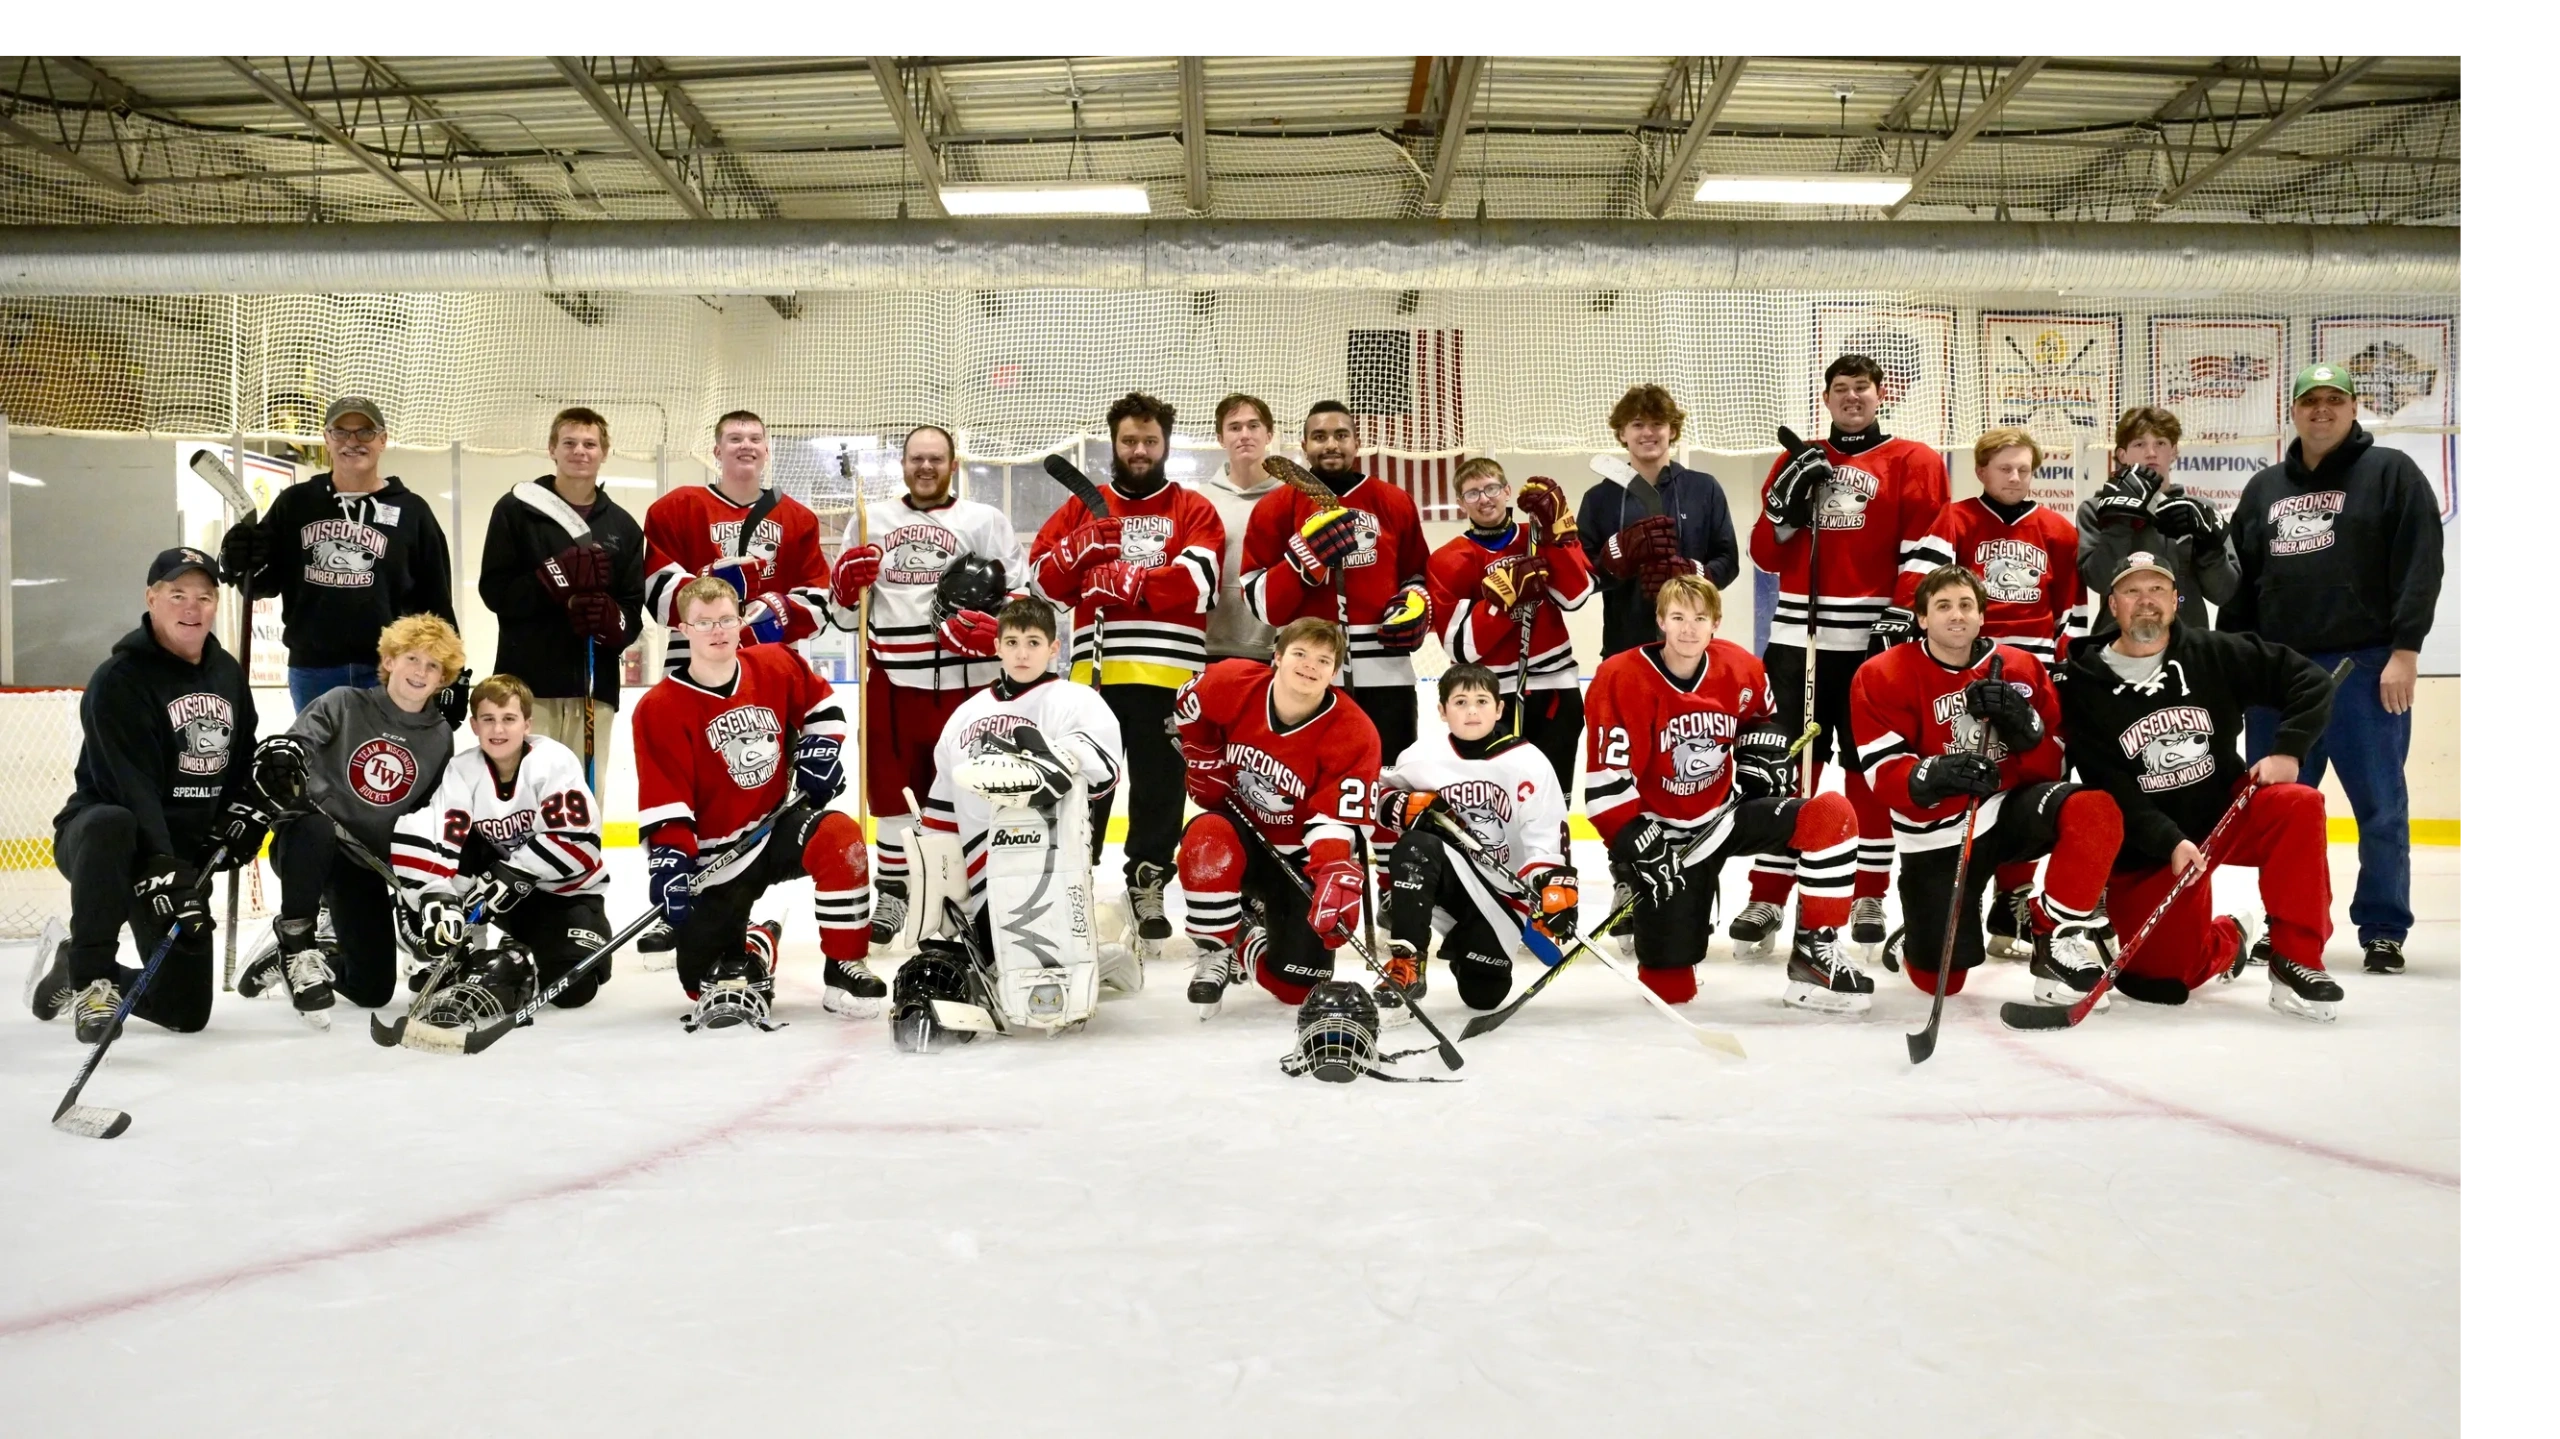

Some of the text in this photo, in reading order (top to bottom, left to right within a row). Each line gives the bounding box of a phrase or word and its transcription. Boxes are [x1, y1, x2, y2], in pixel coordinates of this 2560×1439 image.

[2176, 456, 2269, 471] HAMPIONS
[1828, 466, 1879, 500] CONSIN
[2268, 492, 2344, 523] WISCONSIN
[1121, 515, 1173, 536] CONSIN
[1829, 515, 1864, 528] WOLVES
[885, 525, 956, 556] WISCONSIN
[2298, 534, 2333, 552] WOLVES
[1348, 552, 1377, 567] WOLVES
[304, 567, 373, 586] TIMBER WOLVES
[885, 568, 912, 584] TIMBER
[2008, 588, 2040, 601] WOLVES
[168, 692, 233, 730] WISCONSIN
[382, 731, 407, 742] CCM
[2121, 706, 2214, 759] WISCONSIN
[794, 746, 839, 761] AUER
[1598, 726, 1631, 767] 2
[180, 753, 206, 772] TIMBER
[358, 743, 414, 776] TEAM WISCONSIN
[369, 757, 403, 789] TW
[1225, 743, 1307, 801] WISCONSIN
[2141, 757, 2214, 792] TIMBER WOLVES
[172, 786, 211, 798] SPECIAL
[359, 783, 391, 803] HOCKEY
[1517, 780, 1535, 803] C
[1661, 775, 1696, 797] TIMBER
[541, 789, 592, 829] 29
[1256, 808, 1294, 826] WOLVES
[688, 850, 734, 889] NEXUS
[1394, 880, 1423, 891] CCM
[1349, 936, 1390, 979] KOHO
[1464, 951, 1510, 968] BAUER
[1284, 963, 1333, 980] BAUER
[515, 977, 570, 1025] BAUER
